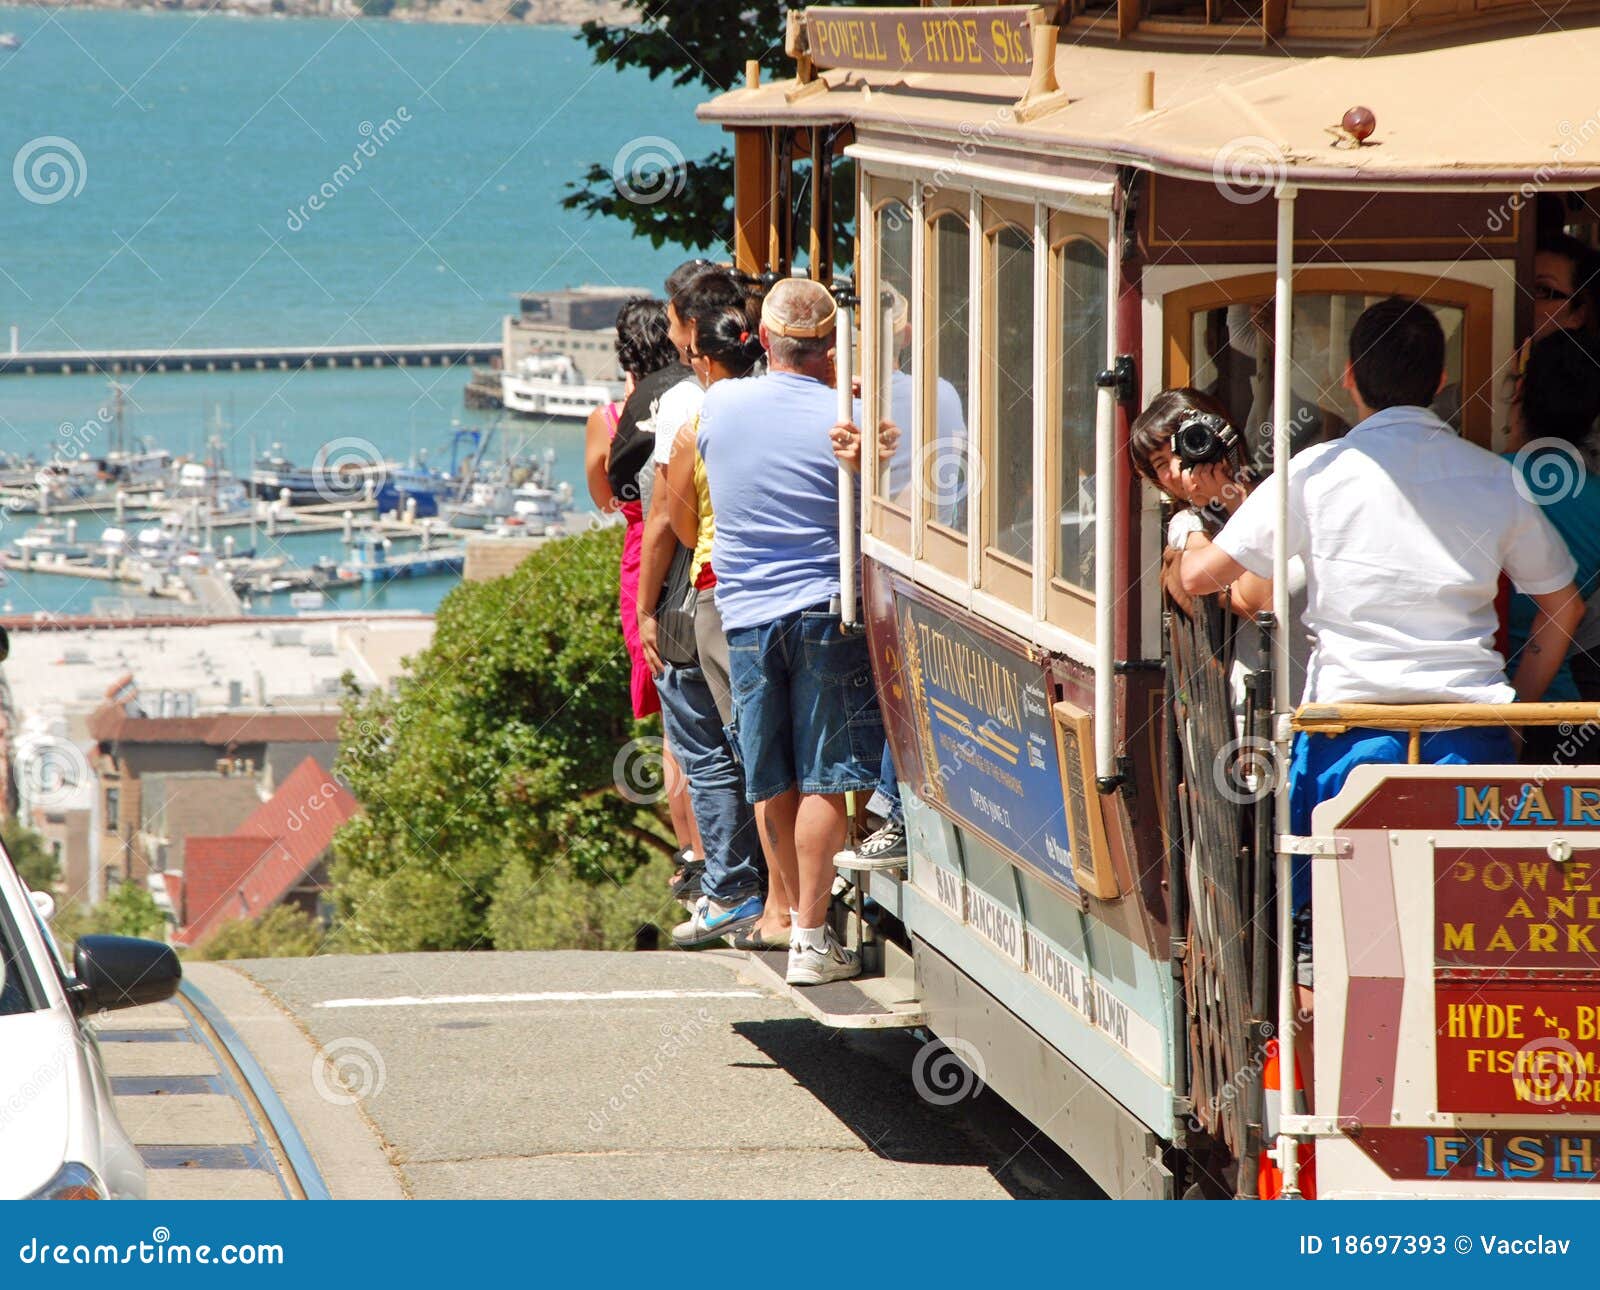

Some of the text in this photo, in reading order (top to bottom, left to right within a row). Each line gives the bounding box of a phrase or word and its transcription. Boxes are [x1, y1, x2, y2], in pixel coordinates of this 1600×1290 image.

[815, 19, 1029, 64] POWELL & HYDE Sts.
[918, 622, 1022, 734] TUTANKHAMUN
[1455, 784, 1600, 826] MAR
[935, 865, 958, 913] SAN
[963, 885, 1017, 958] RANCISCO
[1081, 975, 1130, 1050] RILWAY
[1443, 922, 1599, 952] MARK
[1447, 1004, 1524, 1039] HYDE
[1532, 1006, 1571, 1041] AND
[1467, 1049, 1600, 1075] FISHERM
[1424, 1135, 1596, 1179] FISH
